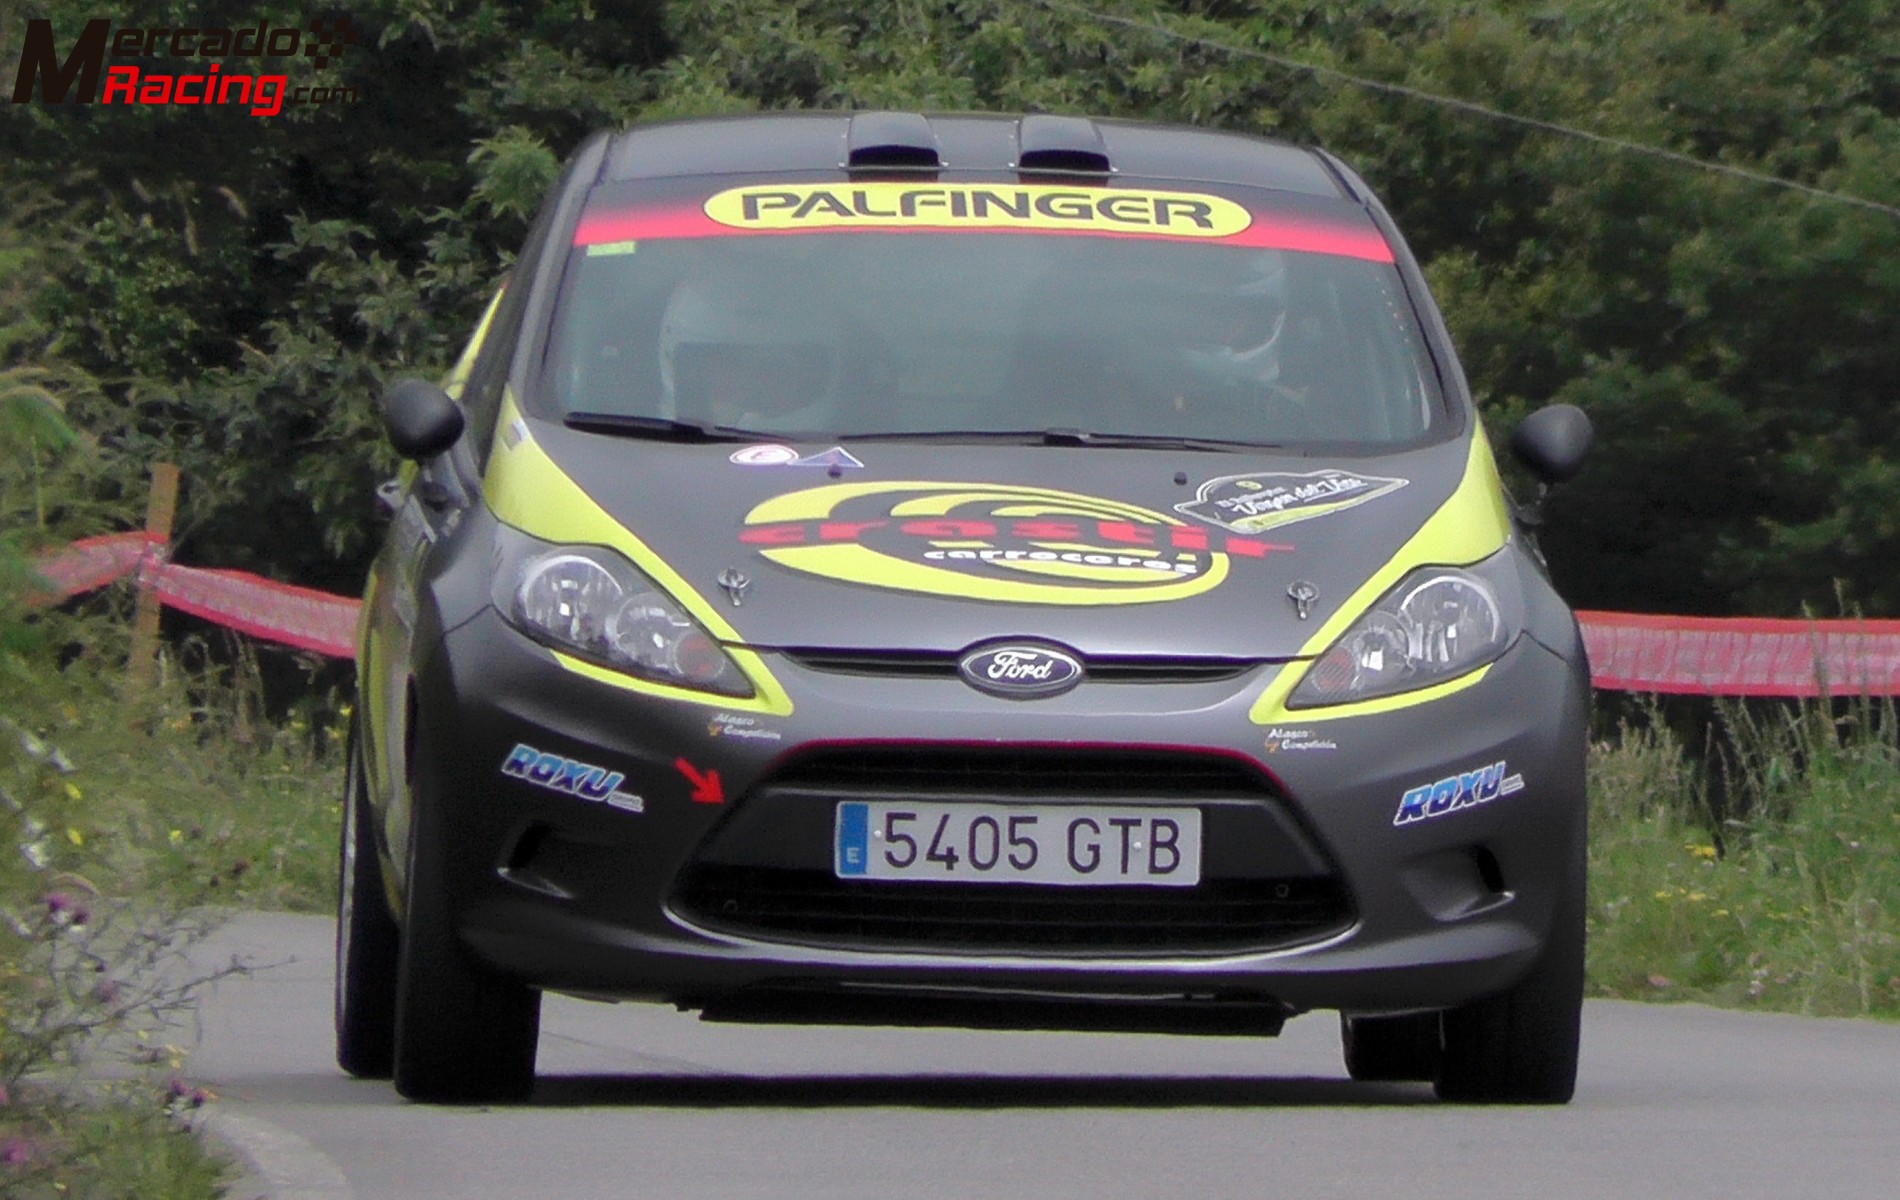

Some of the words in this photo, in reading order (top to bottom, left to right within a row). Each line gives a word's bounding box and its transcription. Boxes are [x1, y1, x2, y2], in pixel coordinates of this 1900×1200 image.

[742, 190, 1214, 229] PALFINGER
[988, 651, 1054, 679] Ford
[501, 743, 625, 801] ROXU
[1393, 760, 1506, 826] ROXU
[846, 847, 860, 863] E
[884, 811, 1039, 871] 5405
[1067, 817, 1181, 875] GTB
